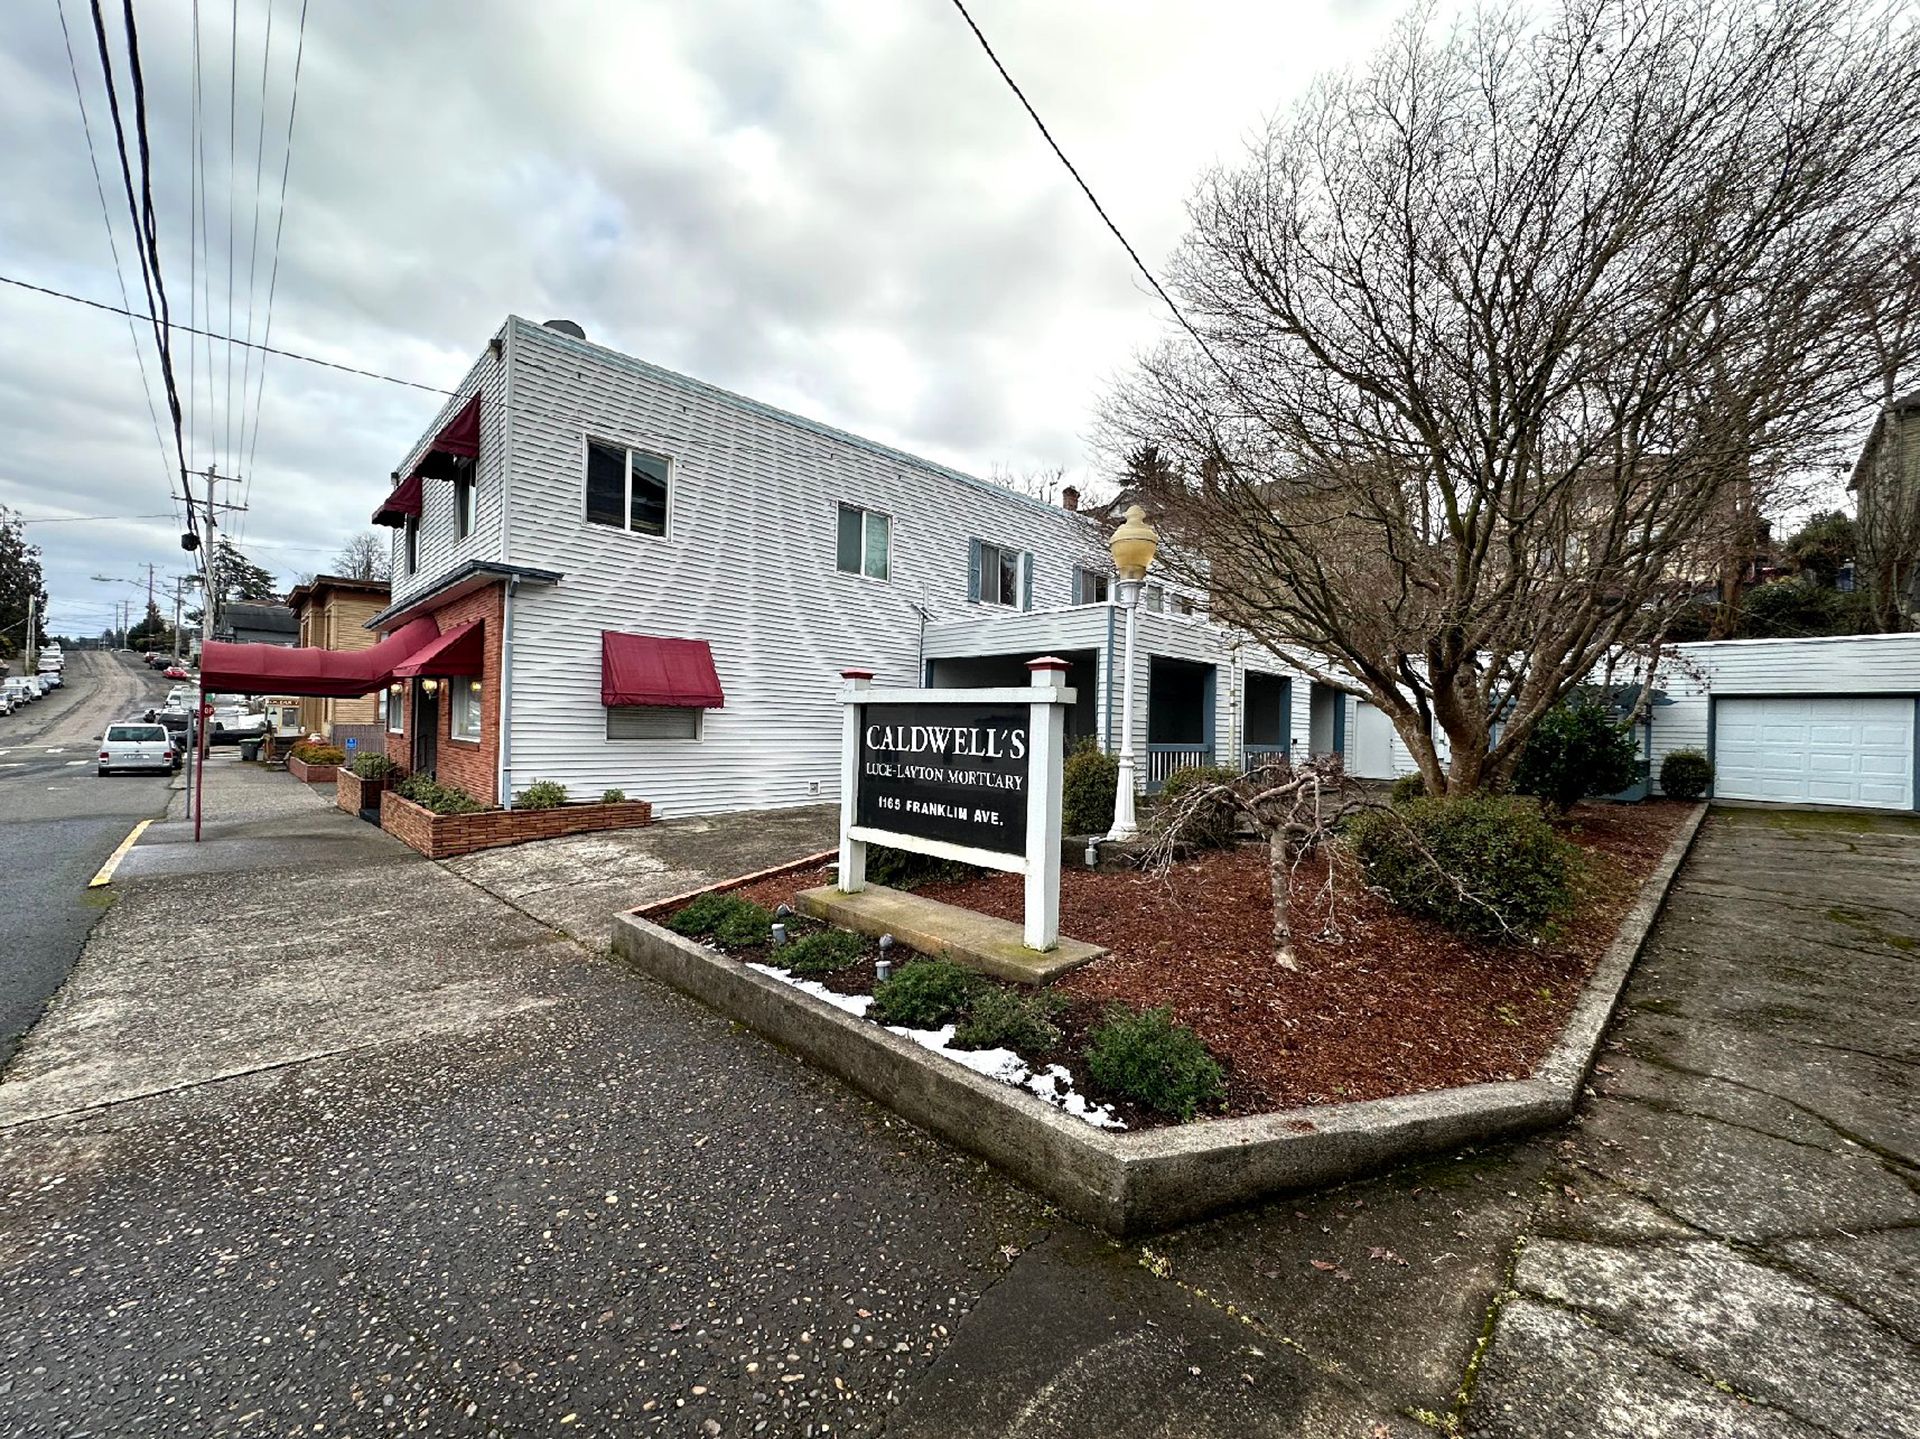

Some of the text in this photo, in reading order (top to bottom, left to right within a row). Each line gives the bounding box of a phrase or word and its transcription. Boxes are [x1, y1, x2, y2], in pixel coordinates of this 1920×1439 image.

[866, 725, 1025, 759] CALDWELL'S
[866, 762, 1023, 790] LUCE-LAYTON MORTUARY
[878, 796, 901, 810] 1165
[973, 809, 1004, 826] AVE.
